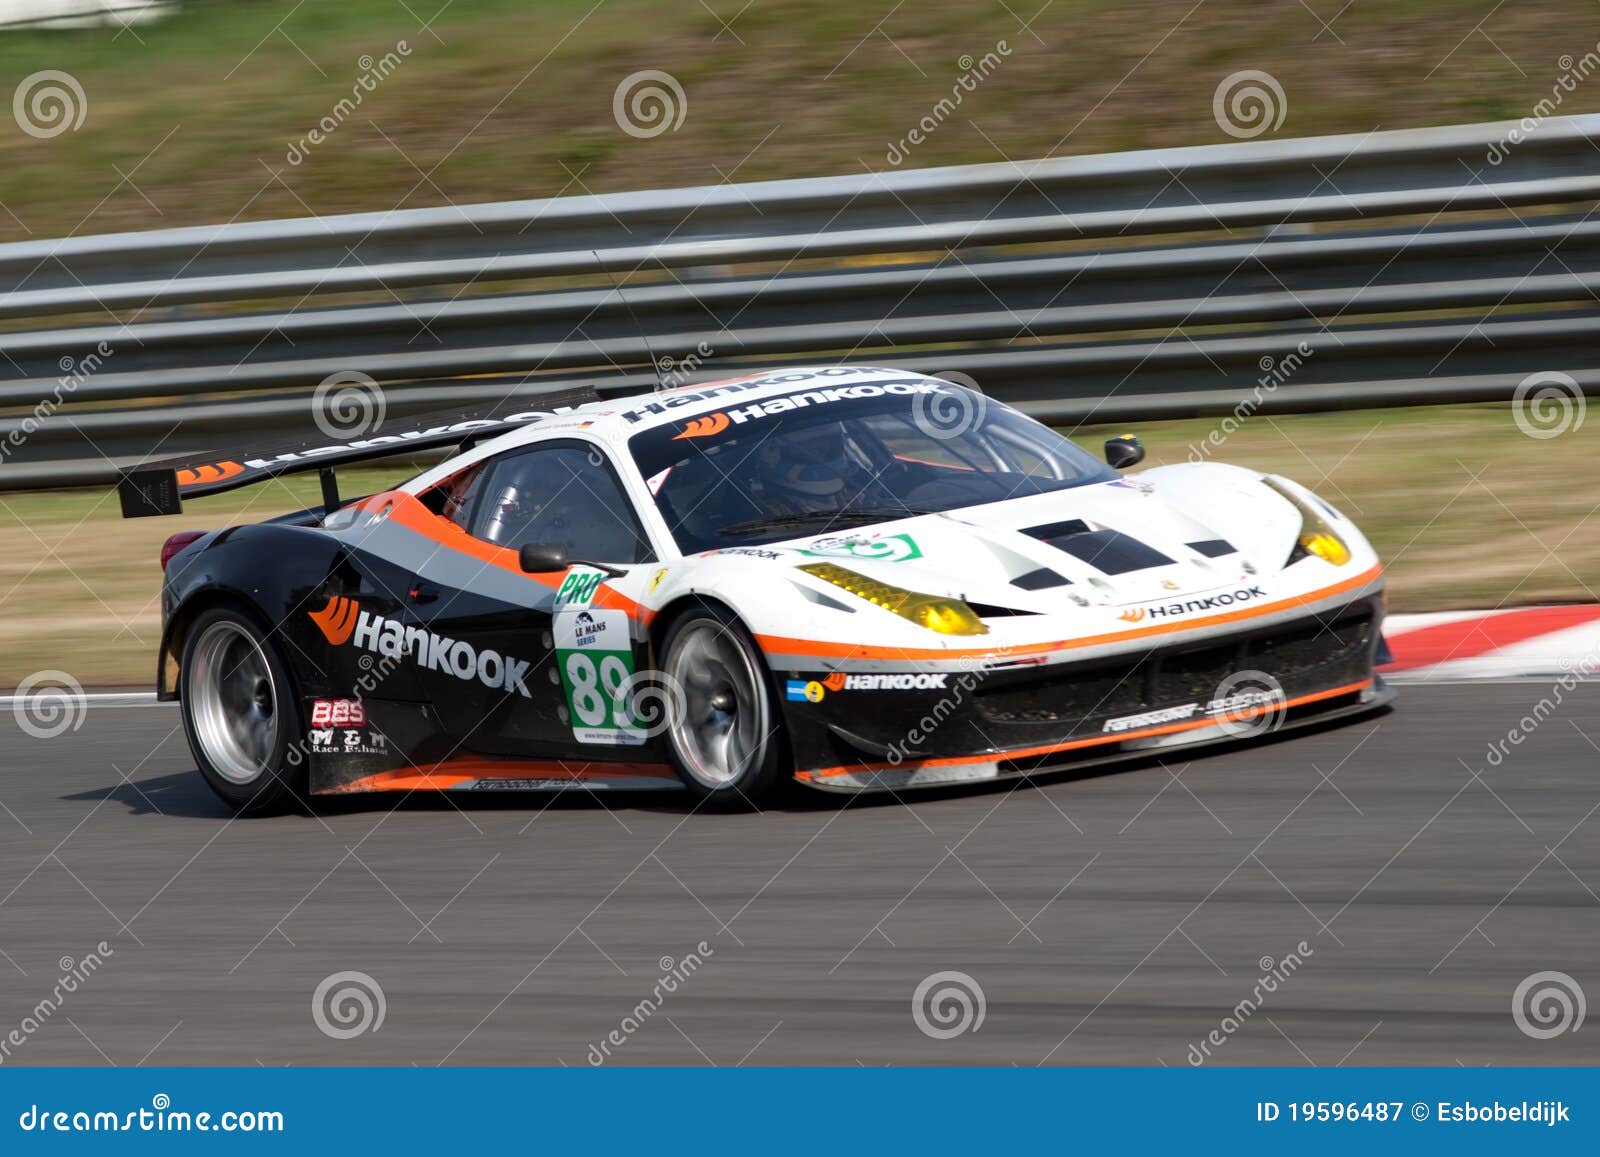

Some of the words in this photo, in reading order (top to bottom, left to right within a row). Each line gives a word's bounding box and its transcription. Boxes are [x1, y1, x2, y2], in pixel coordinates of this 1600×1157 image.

[556, 573, 602, 604] PRO
[575, 627, 583, 637] LE
[585, 621, 606, 635] MANS
[576, 635, 596, 647] SERIES
[566, 652, 636, 726] 89
[312, 701, 363, 723] BBS
[312, 744, 340, 753] Race
